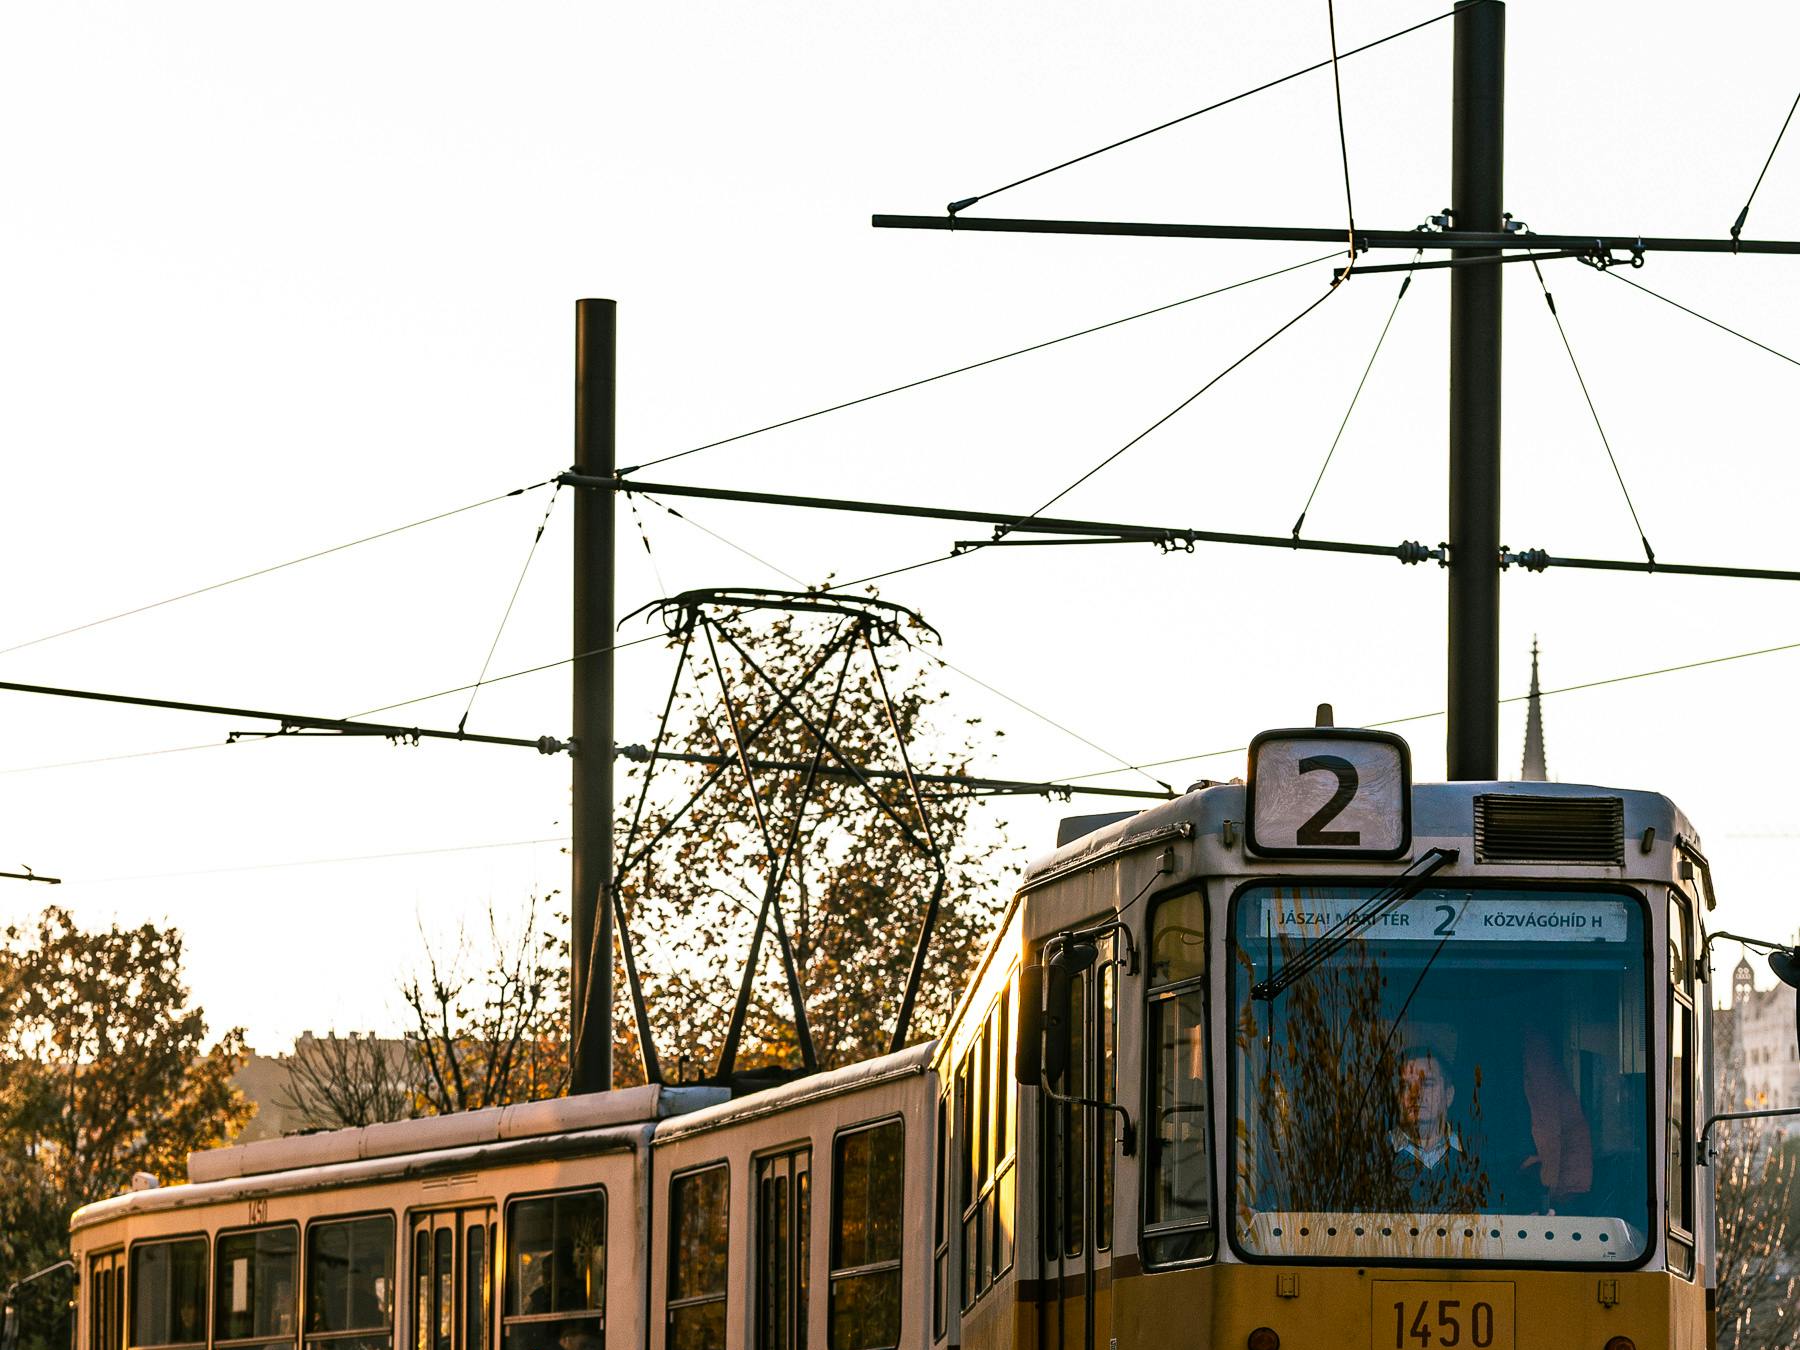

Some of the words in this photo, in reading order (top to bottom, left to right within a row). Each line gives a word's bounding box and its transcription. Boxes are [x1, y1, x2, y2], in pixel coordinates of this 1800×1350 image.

[1296, 754, 1361, 846] 2
[1278, 909, 1331, 926] JÁSZAI
[1382, 910, 1410, 926] TÉR
[1433, 904, 1457, 937] 2
[1483, 912, 1587, 928] KÖZVÁGÓHÍD
[1591, 915, 1603, 928] H
[1393, 1300, 1494, 1350] 1450
